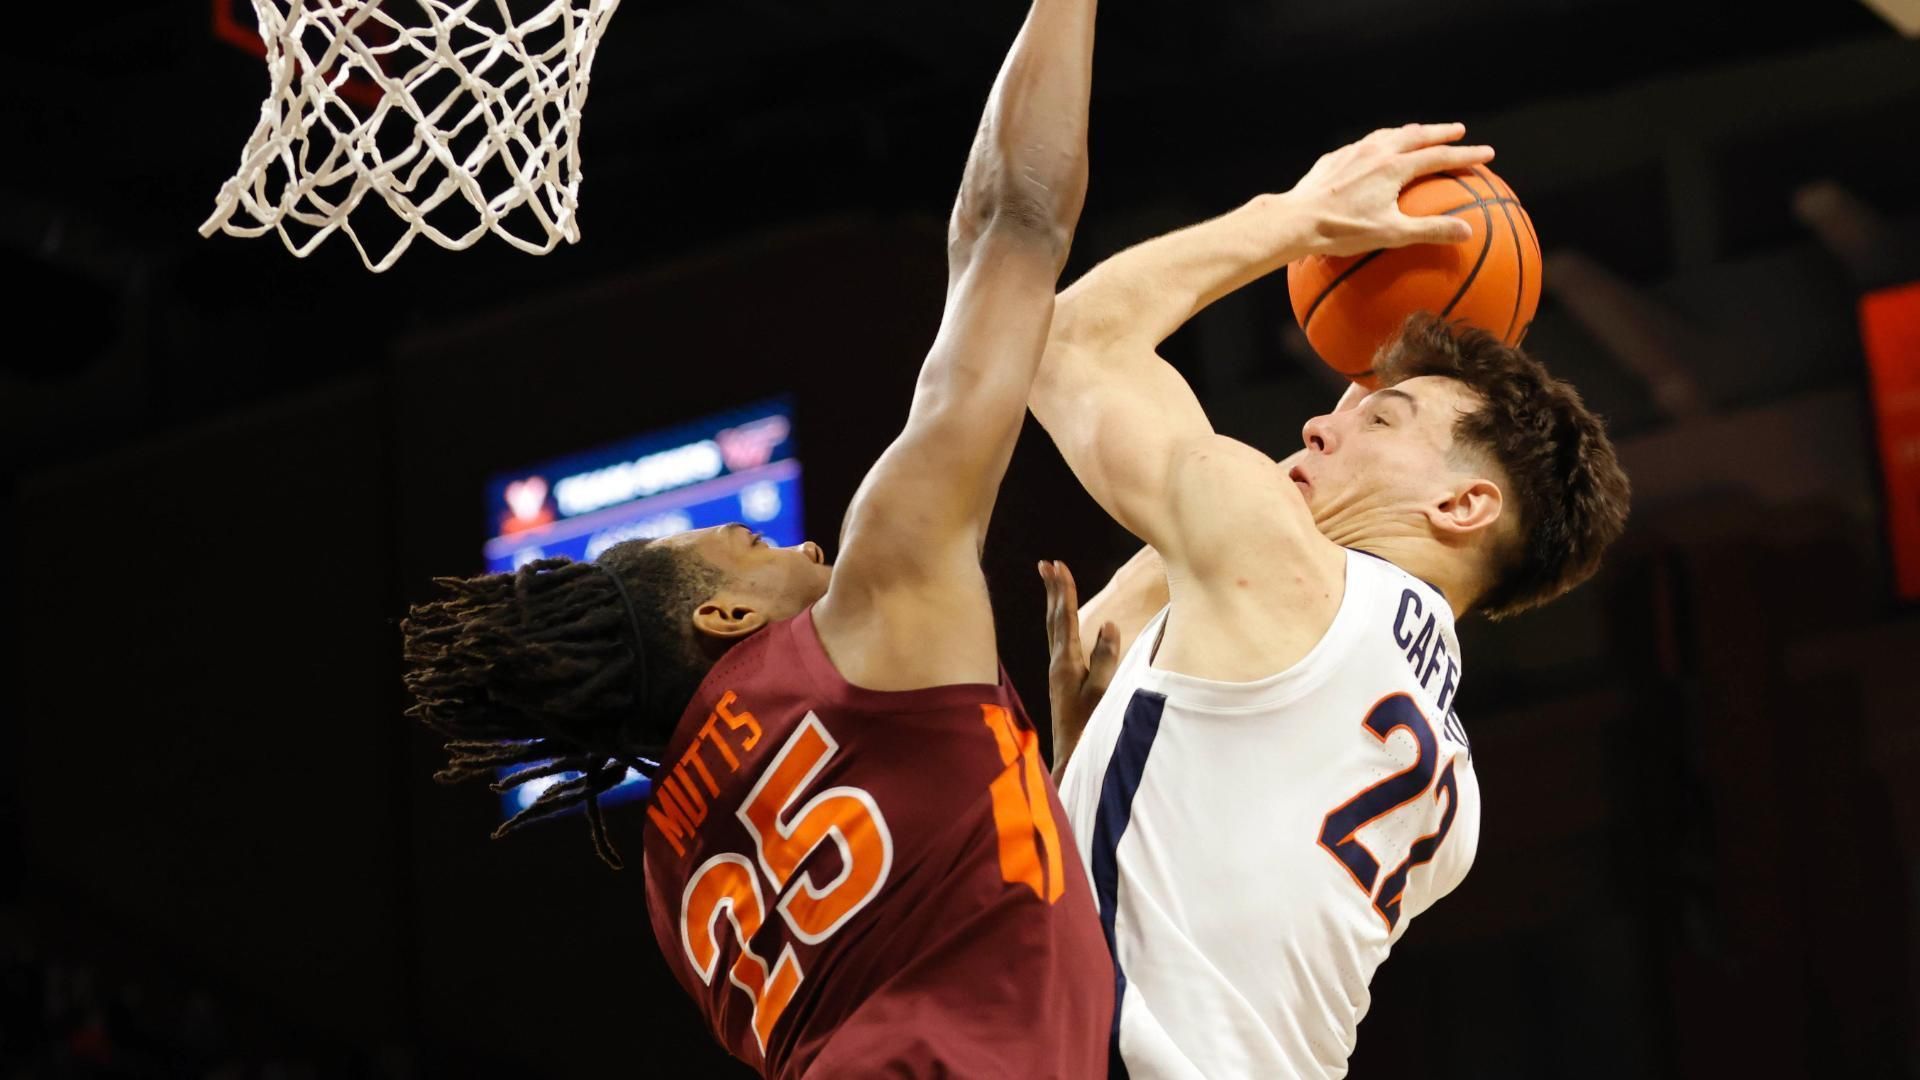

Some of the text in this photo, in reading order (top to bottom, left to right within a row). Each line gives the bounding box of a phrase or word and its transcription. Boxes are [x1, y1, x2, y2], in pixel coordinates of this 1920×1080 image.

[646, 690, 763, 858] MUTTS
[1393, 588, 1471, 761] CAFF
[681, 710, 893, 1058] 25
[1317, 691, 1458, 935] 22
